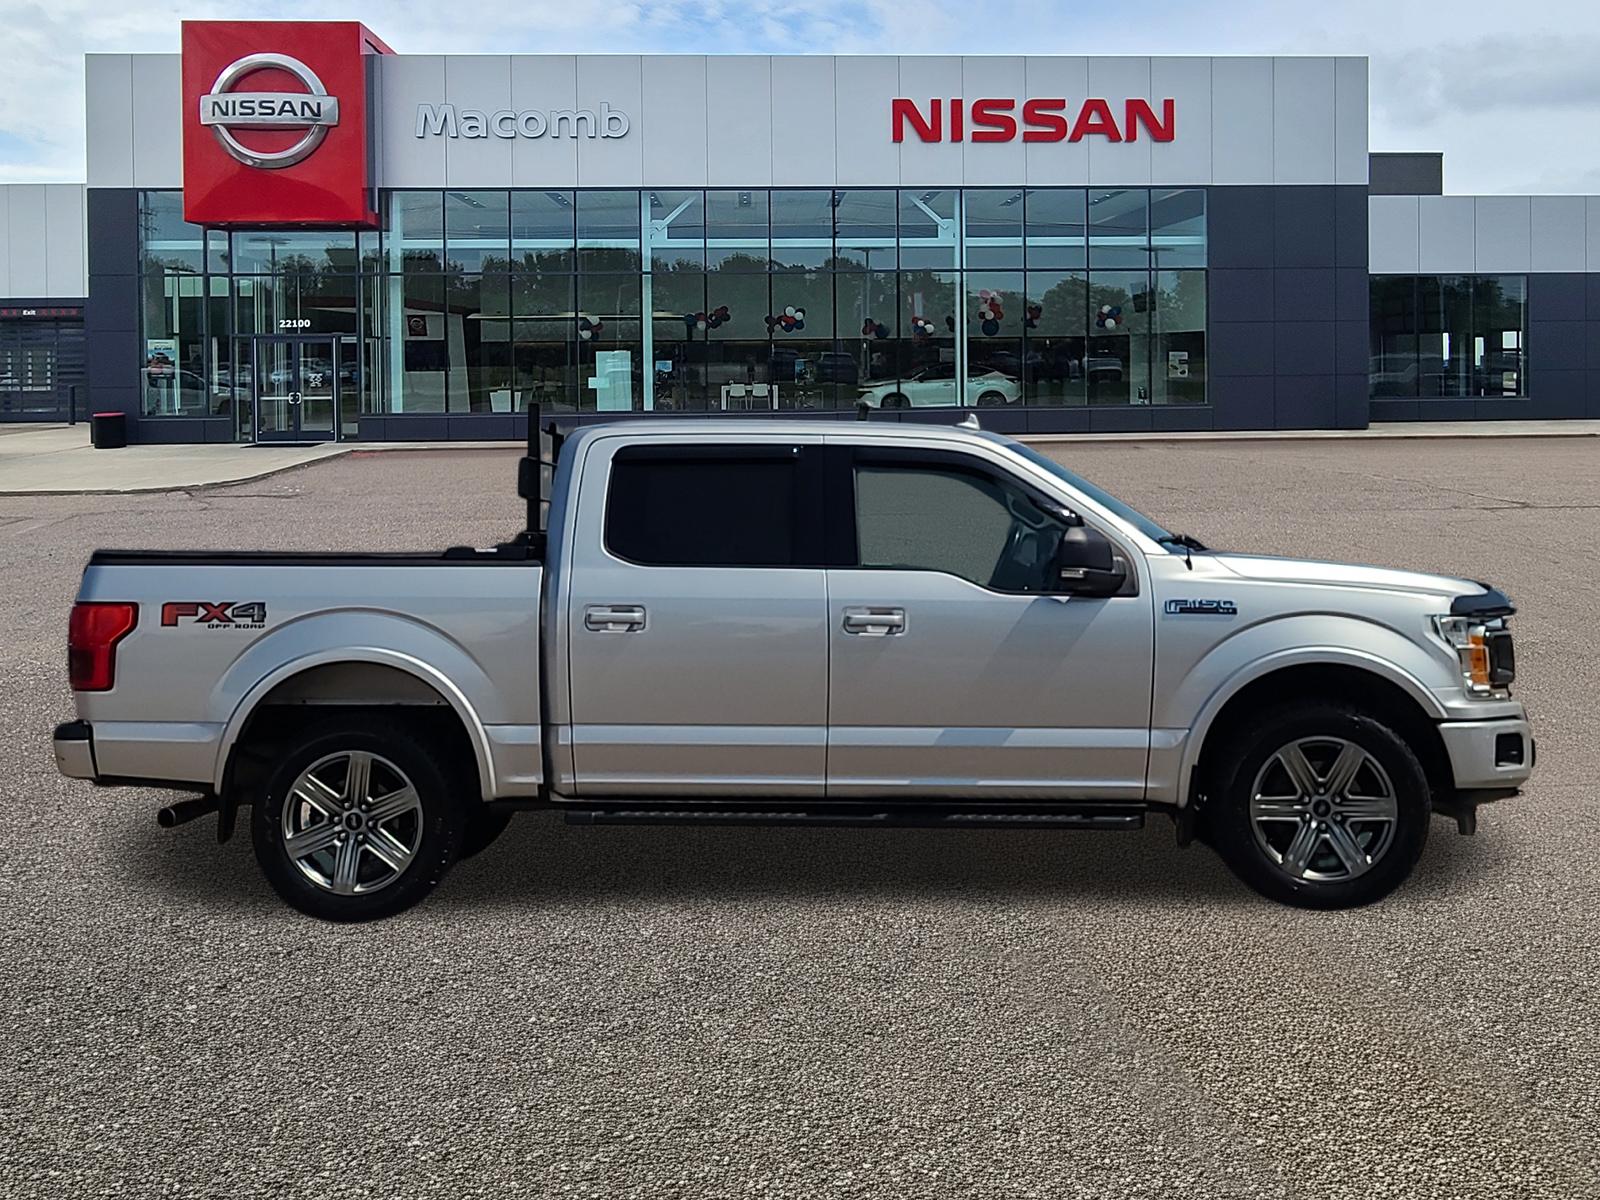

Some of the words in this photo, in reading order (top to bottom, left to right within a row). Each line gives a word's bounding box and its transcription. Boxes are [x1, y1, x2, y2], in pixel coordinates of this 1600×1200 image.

[211, 100, 322, 117] NISSAN
[415, 102, 630, 139] Macomb
[892, 99, 1175, 143] NISSAN
[279, 319, 311, 328] 22100
[161, 602, 266, 627] FX4
